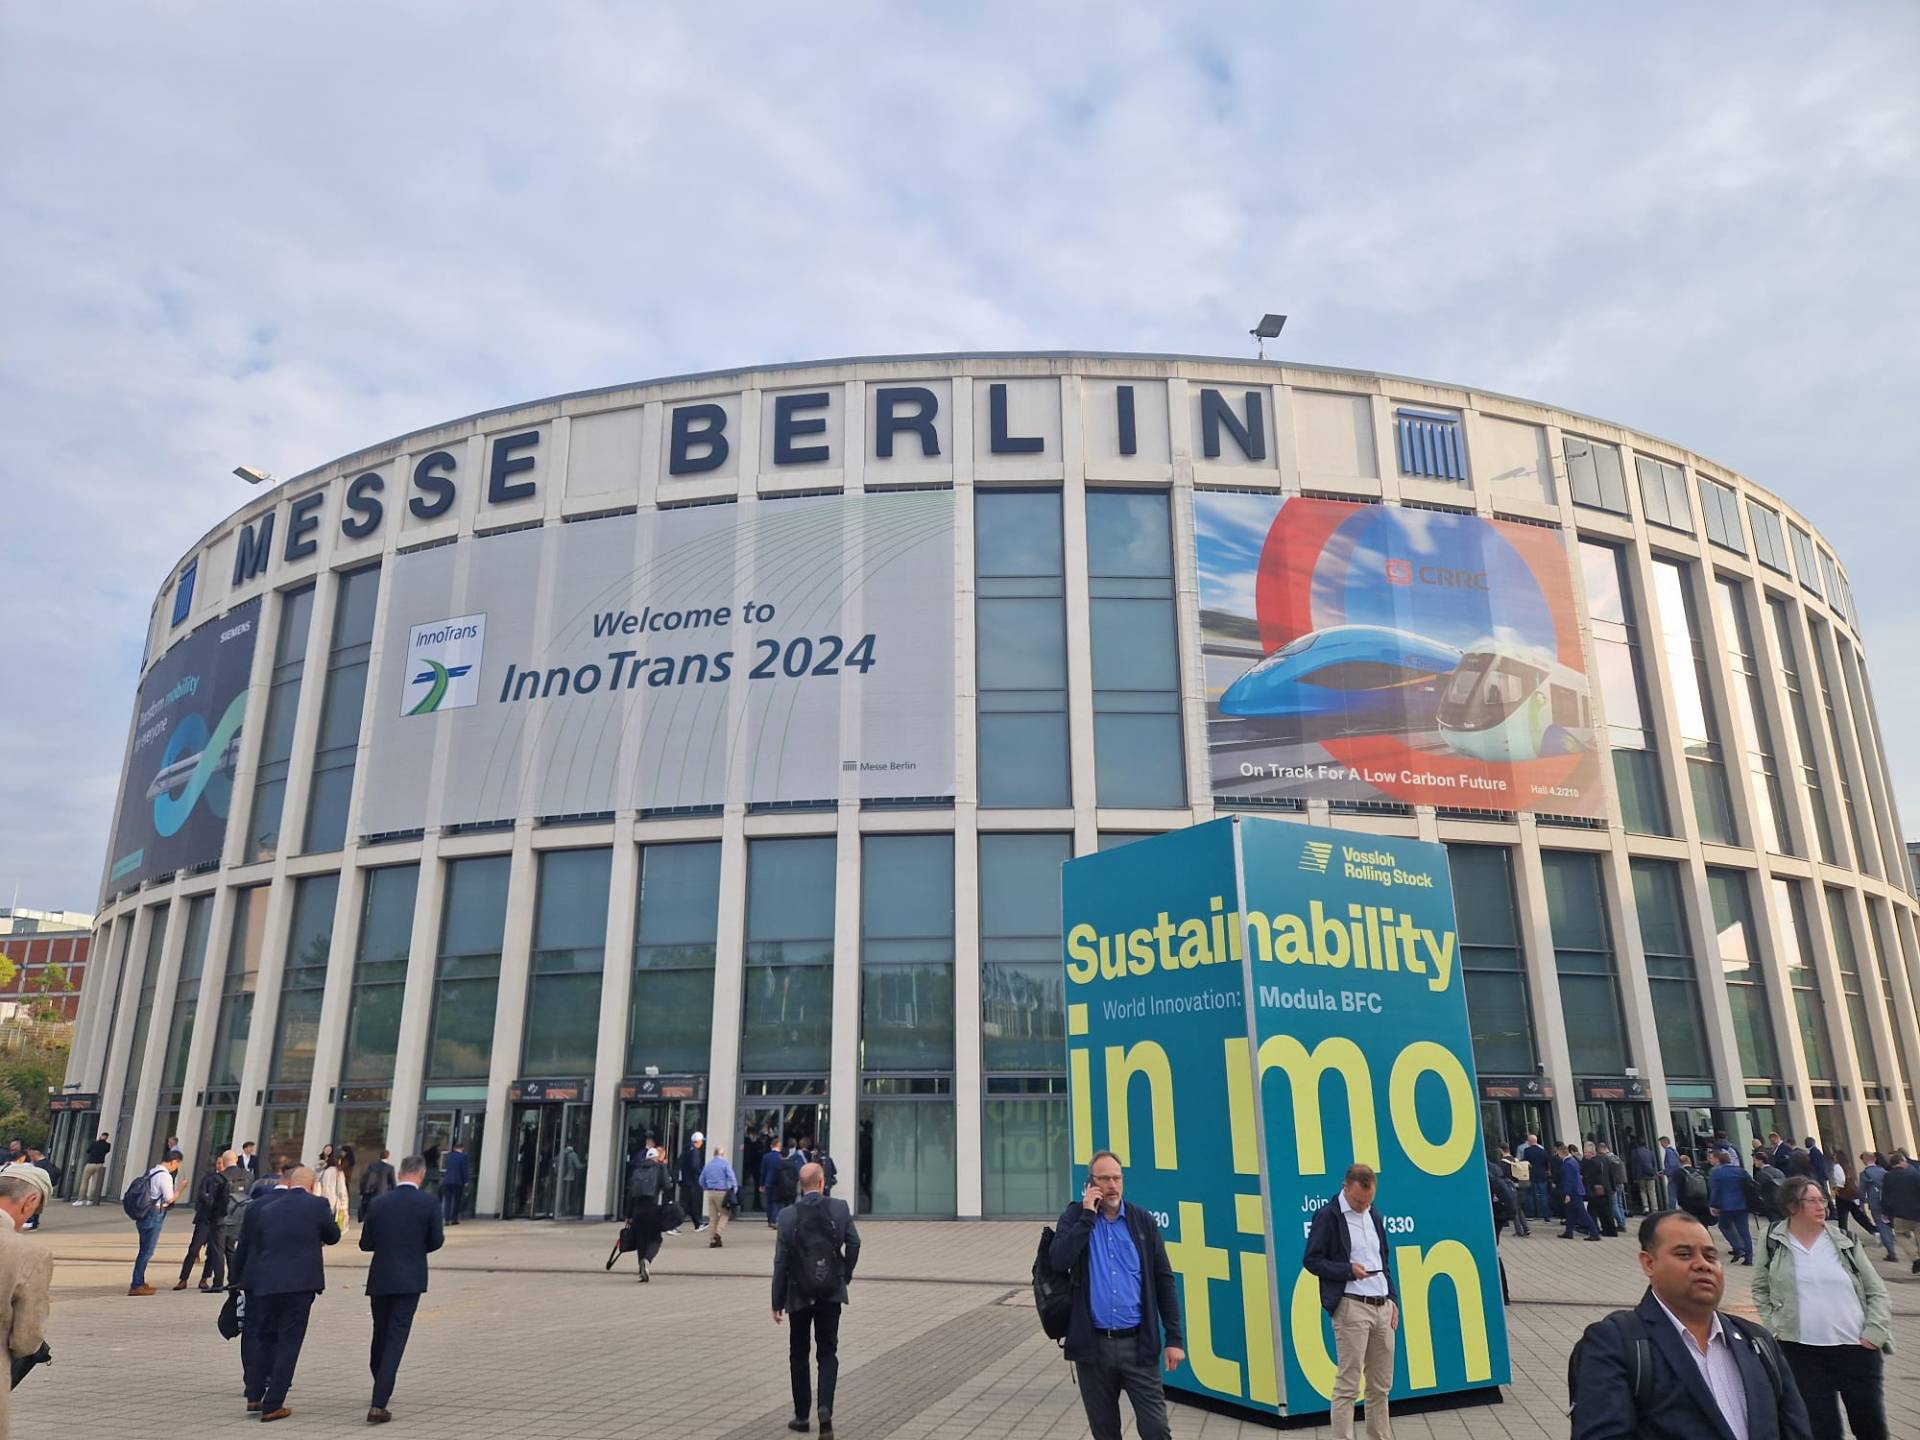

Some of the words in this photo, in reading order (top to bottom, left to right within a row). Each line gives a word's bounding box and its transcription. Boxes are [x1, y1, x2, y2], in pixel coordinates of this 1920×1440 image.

[232, 431, 540, 586] MESSE
[669, 383, 1267, 475] BERLIN
[1419, 566, 1489, 591] CRRC
[219, 621, 251, 643] SIEMENS
[592, 606, 731, 638] Welcome
[742, 601, 775, 625] to
[416, 624, 478, 647] InnoTrans
[498, 649, 734, 703] InnoTrans
[748, 633, 877, 680] 2024
[165, 674, 200, 706] mobility
[860, 762, 888, 771] Messe
[890, 761, 917, 770] Berlin
[1240, 762, 1264, 777] On
[1269, 763, 1313, 780] Track
[1318, 766, 1345, 781] For
[1348, 767, 1361, 782] A
[1364, 768, 1397, 784] Low
[1400, 770, 1456, 788] Carbon
[1459, 774, 1508, 791] Future
[1530, 784, 1547, 794] Hall
[1342, 845, 1396, 867] Vossloh
[1344, 862, 1392, 887] Rolling
[1393, 868, 1434, 888] Stock
[1066, 895, 1456, 993] Sustainability
[1102, 996, 1146, 1021] World
[1150, 987, 1242, 1016] Innovation:
[1259, 986, 1338, 1012] Modula
[1342, 990, 1383, 1014] BFC
[1068, 1003, 1178, 1170] in
[1224, 1034, 1477, 1176] mo
